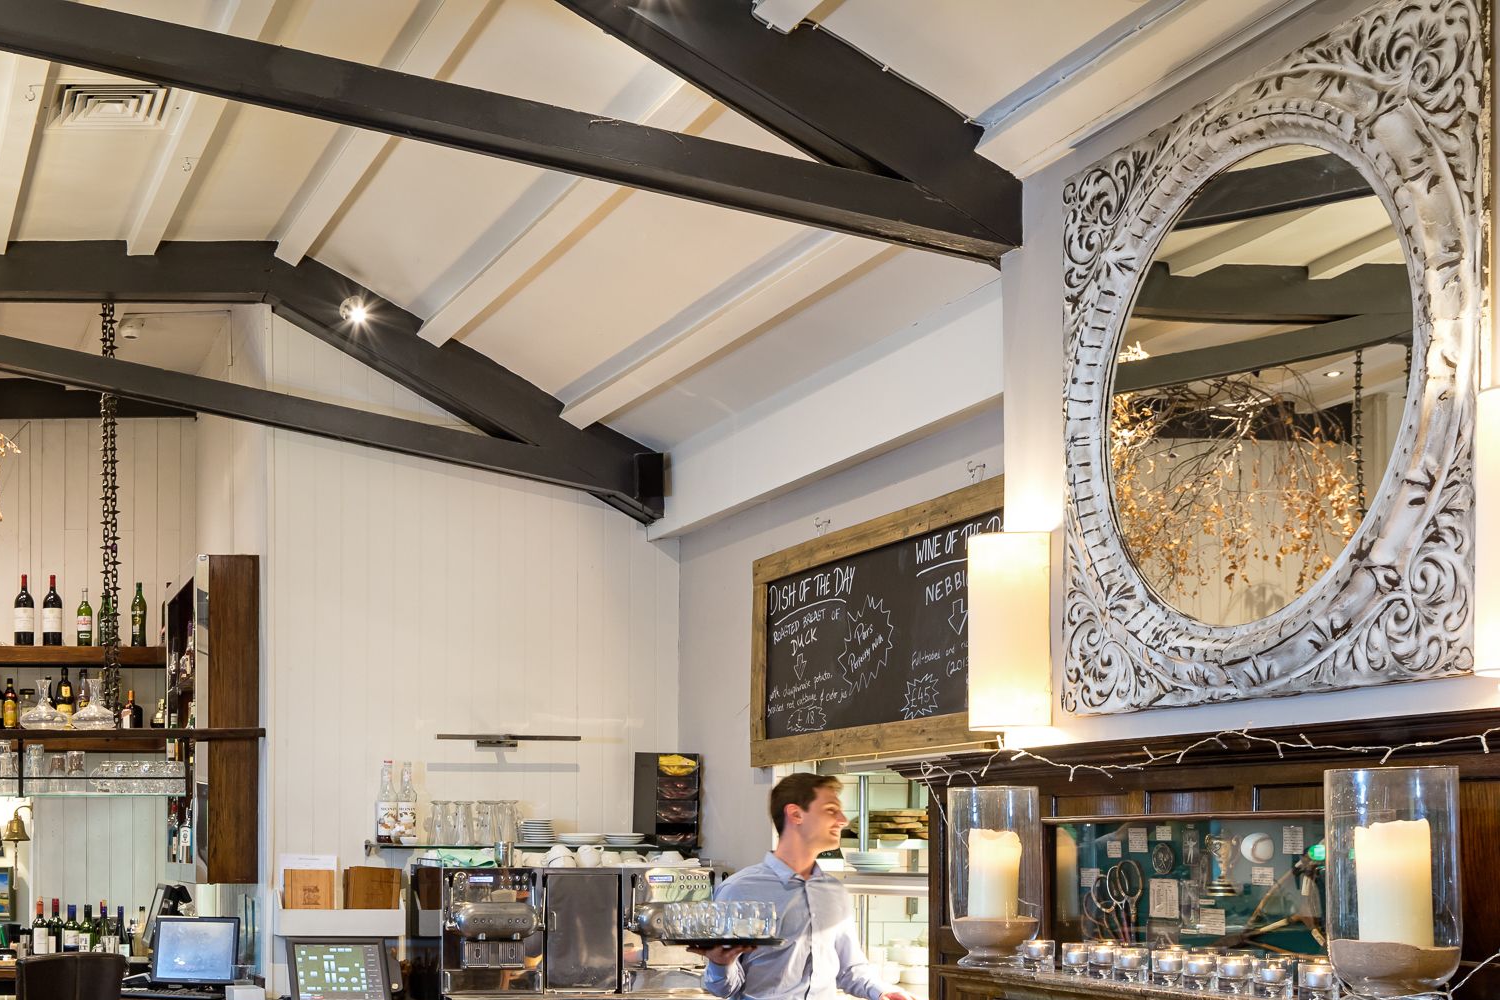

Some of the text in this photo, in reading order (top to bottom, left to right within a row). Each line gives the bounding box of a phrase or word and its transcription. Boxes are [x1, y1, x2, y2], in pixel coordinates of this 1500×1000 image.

[915, 534, 942, 565] WINE
[944, 529, 959, 555] OF
[769, 565, 856, 616] DISH OF THE DAY
[773, 608, 841, 646] ROASTED BREAST OF
[790, 627, 818, 657] DUCK
[911, 686, 930, 708] £45
